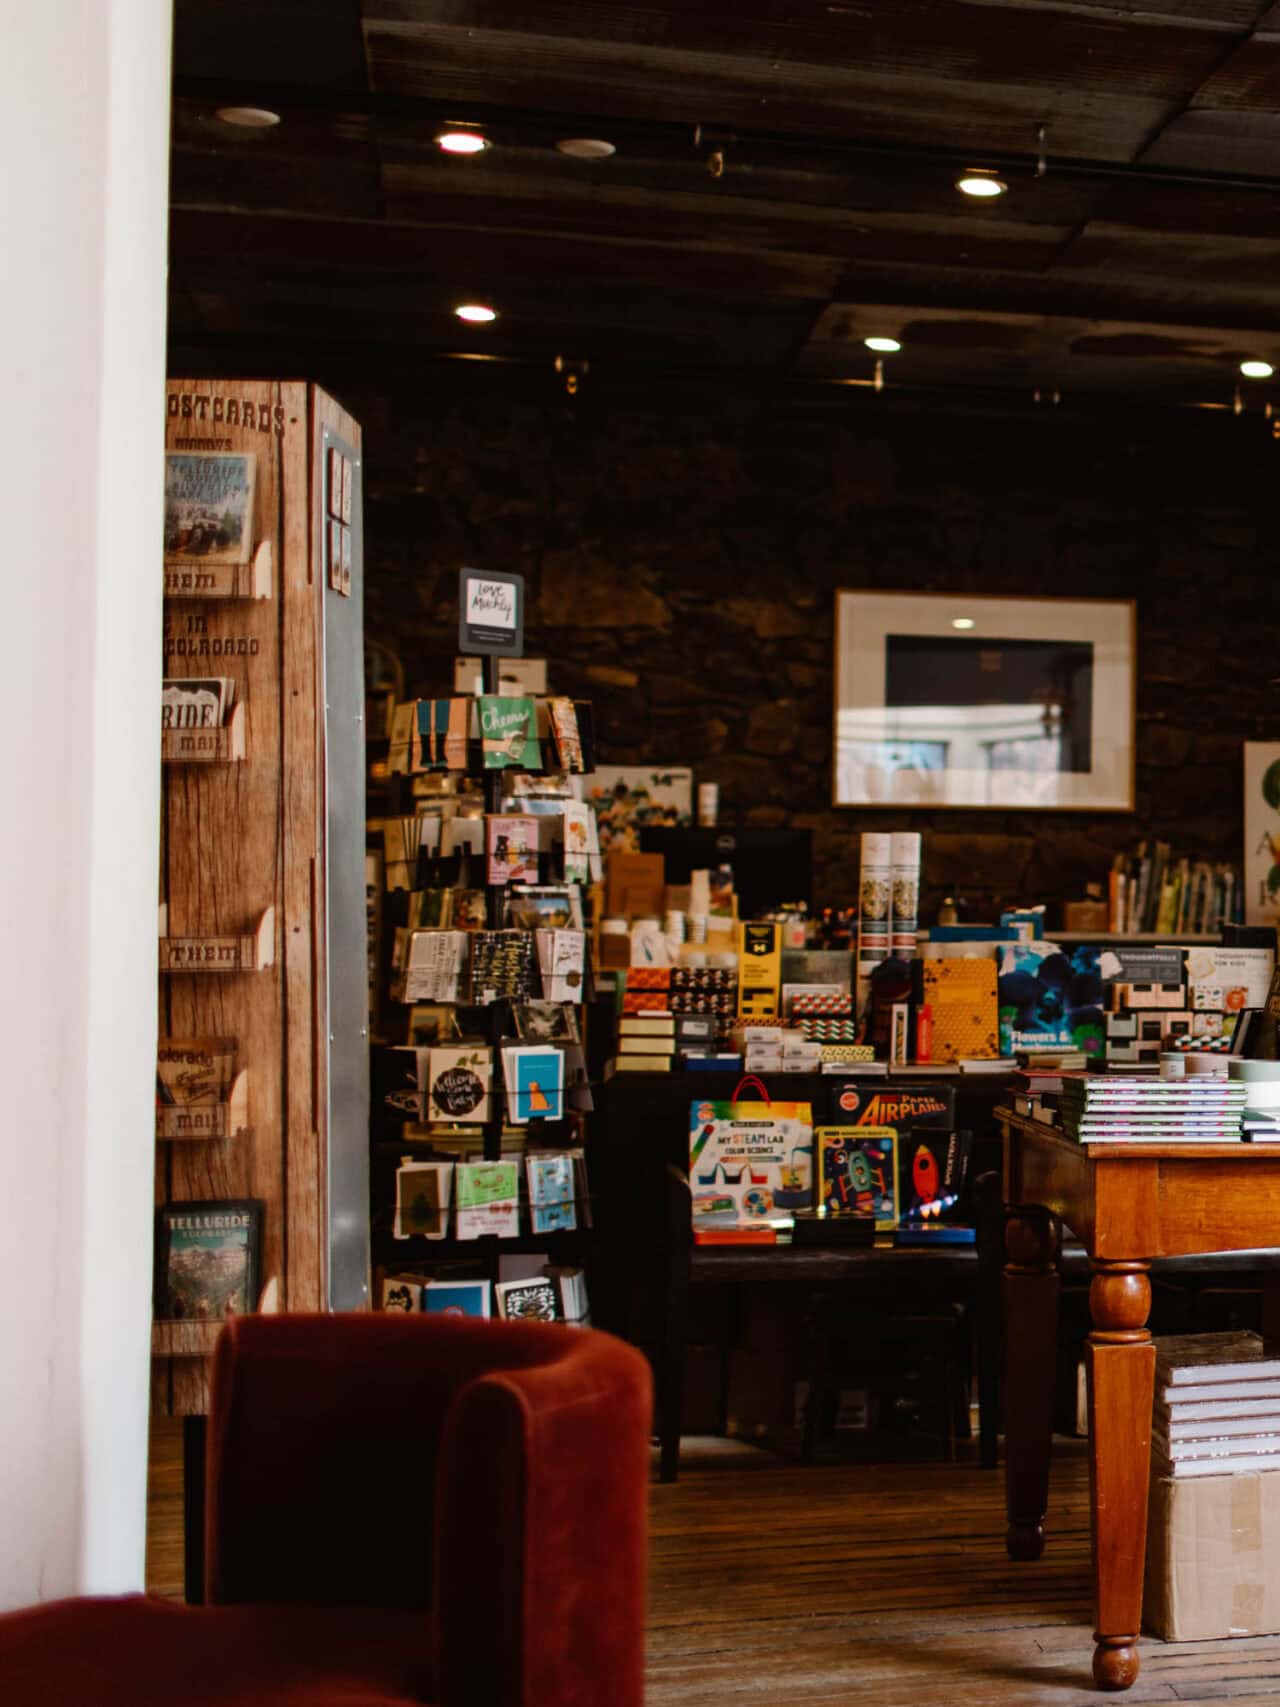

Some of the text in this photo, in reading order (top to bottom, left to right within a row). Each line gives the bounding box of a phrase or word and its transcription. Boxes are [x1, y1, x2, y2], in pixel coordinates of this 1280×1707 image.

[856, 1094, 947, 1127] AIRPLANES
[733, 1133, 767, 1144] STEAM
[169, 1215, 251, 1230] TELLURIDE
